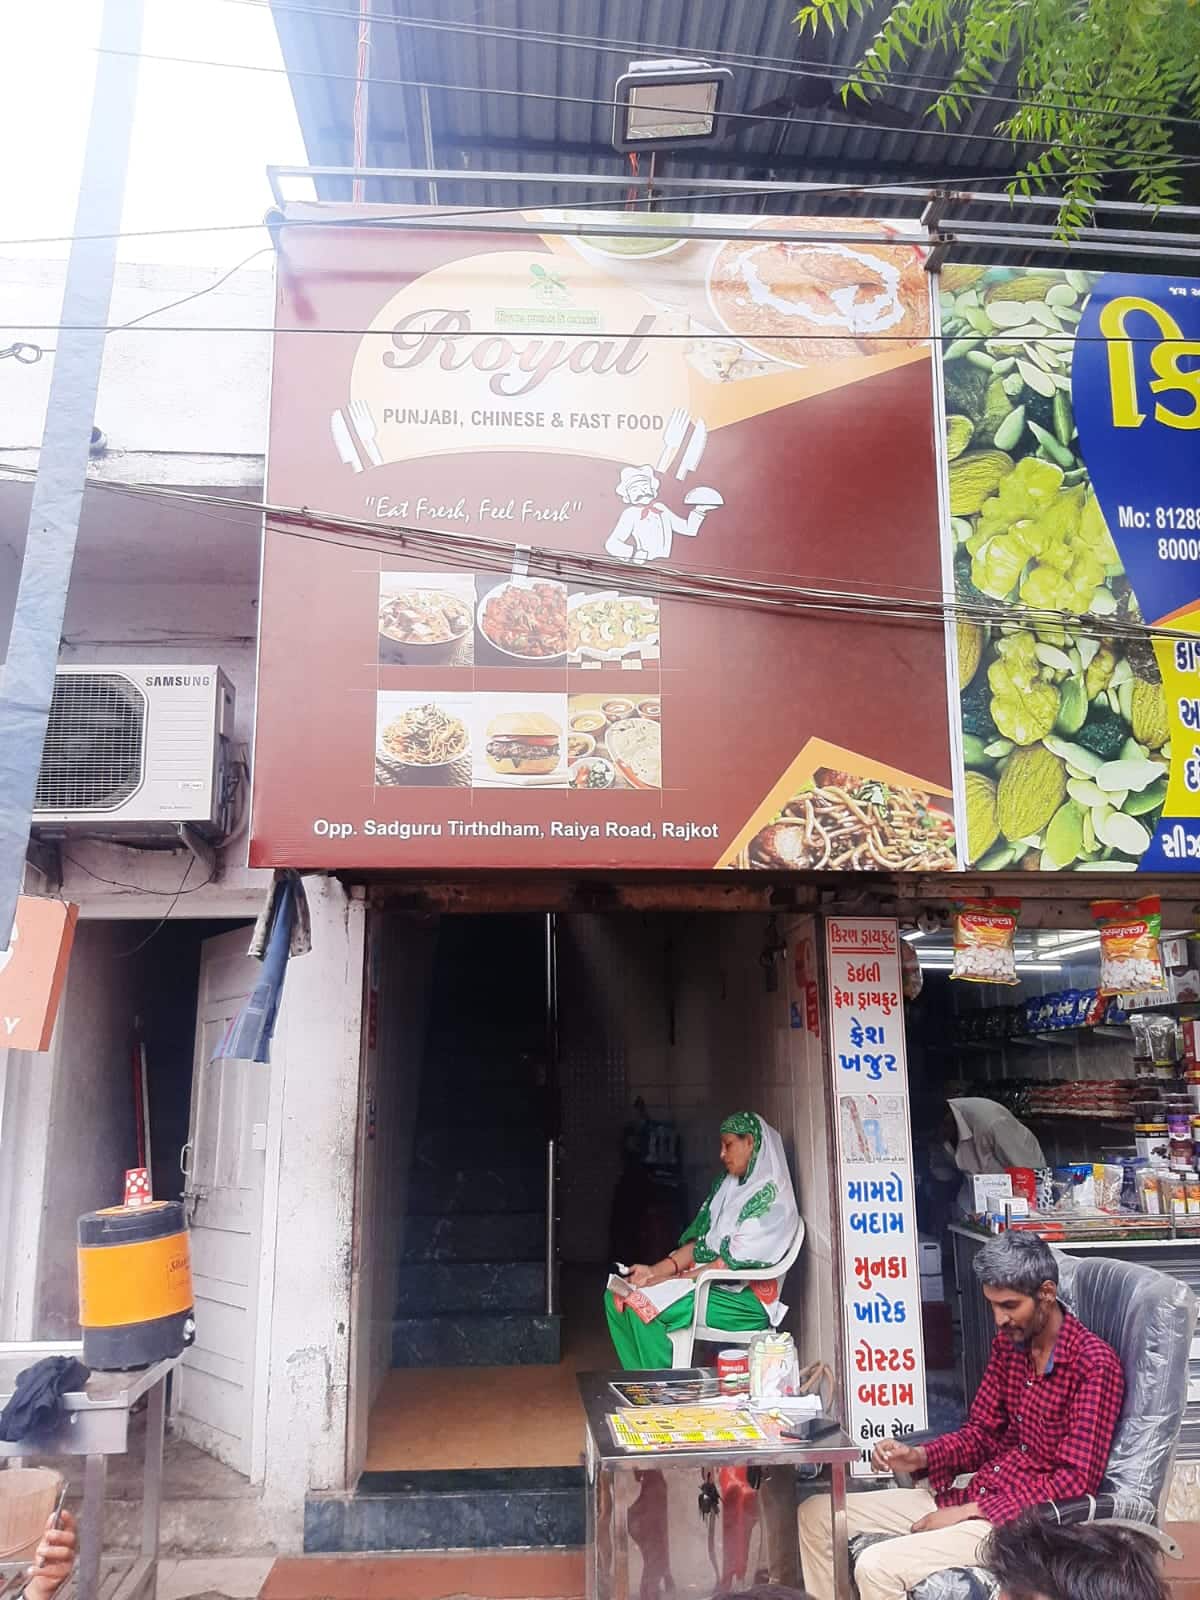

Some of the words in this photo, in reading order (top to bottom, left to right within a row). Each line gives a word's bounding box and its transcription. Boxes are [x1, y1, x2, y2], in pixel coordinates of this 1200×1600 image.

[382, 308, 657, 397] Royal
[383, 408, 464, 428] PUNJABI,
[471, 410, 545, 427] CHINESE
[551, 411, 564, 428] &
[570, 412, 611, 429] FAST
[617, 414, 664, 431] FOOD
[416, 497, 470, 522] Fresh,
[479, 499, 515, 521] Feel
[1118, 505, 1150, 529] Mo:
[1158, 538, 1200, 560] 8000
[145, 676, 210, 687] SAMSUNG
[313, 819, 358, 839] Opp.
[363, 819, 442, 840] Sadguru
[447, 820, 545, 839] Tirthdham,
[551, 821, 600, 841] Raiya
[605, 822, 657, 839] Road,
[662, 822, 719, 843] Rajkot
[831, 923, 858, 944] કિરણ
[838, 1054, 898, 1080] ખજુર
[848, 1171, 903, 1202] મામરો
[850, 1212, 905, 1234] બદામ
[854, 1256, 908, 1290] મુનકા
[854, 1292, 907, 1324] ખારેક
[855, 1339, 916, 1372] રોસ્ટડ
[858, 1383, 914, 1407] બદામ
[860, 1418, 885, 1440] હોલ
